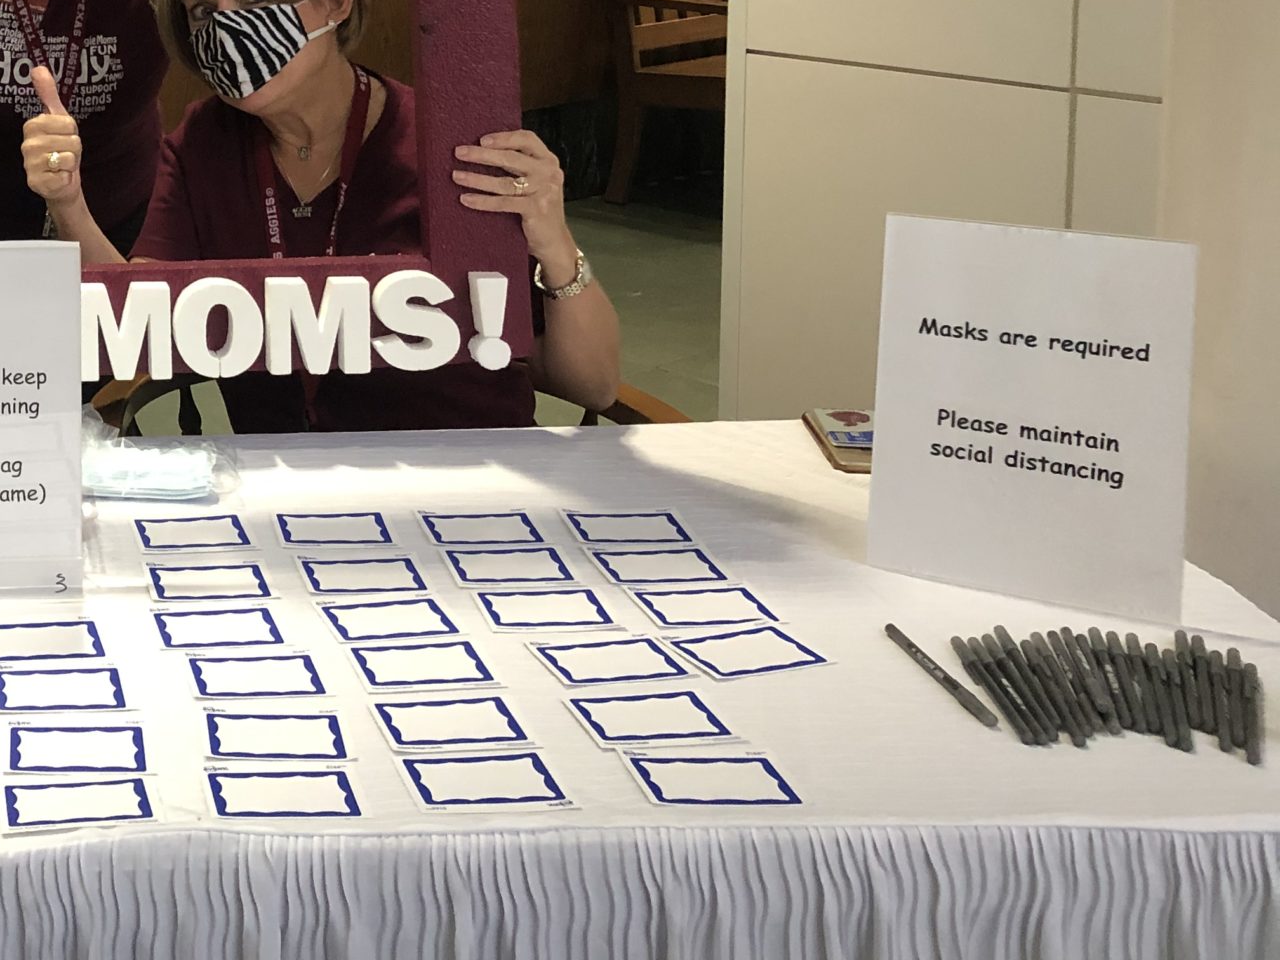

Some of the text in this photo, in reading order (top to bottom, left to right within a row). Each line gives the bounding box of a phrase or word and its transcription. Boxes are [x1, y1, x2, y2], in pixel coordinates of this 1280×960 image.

[90, 44, 117, 56] FUN
[265, 196, 281, 244] AGGIES
[81, 269, 511, 381] MOMS!
[918, 317, 1151, 363] Masks are required
[2, 368, 47, 391] keep
[937, 408, 1120, 453] Please maintain
[929, 442, 1125, 490] social distancing
